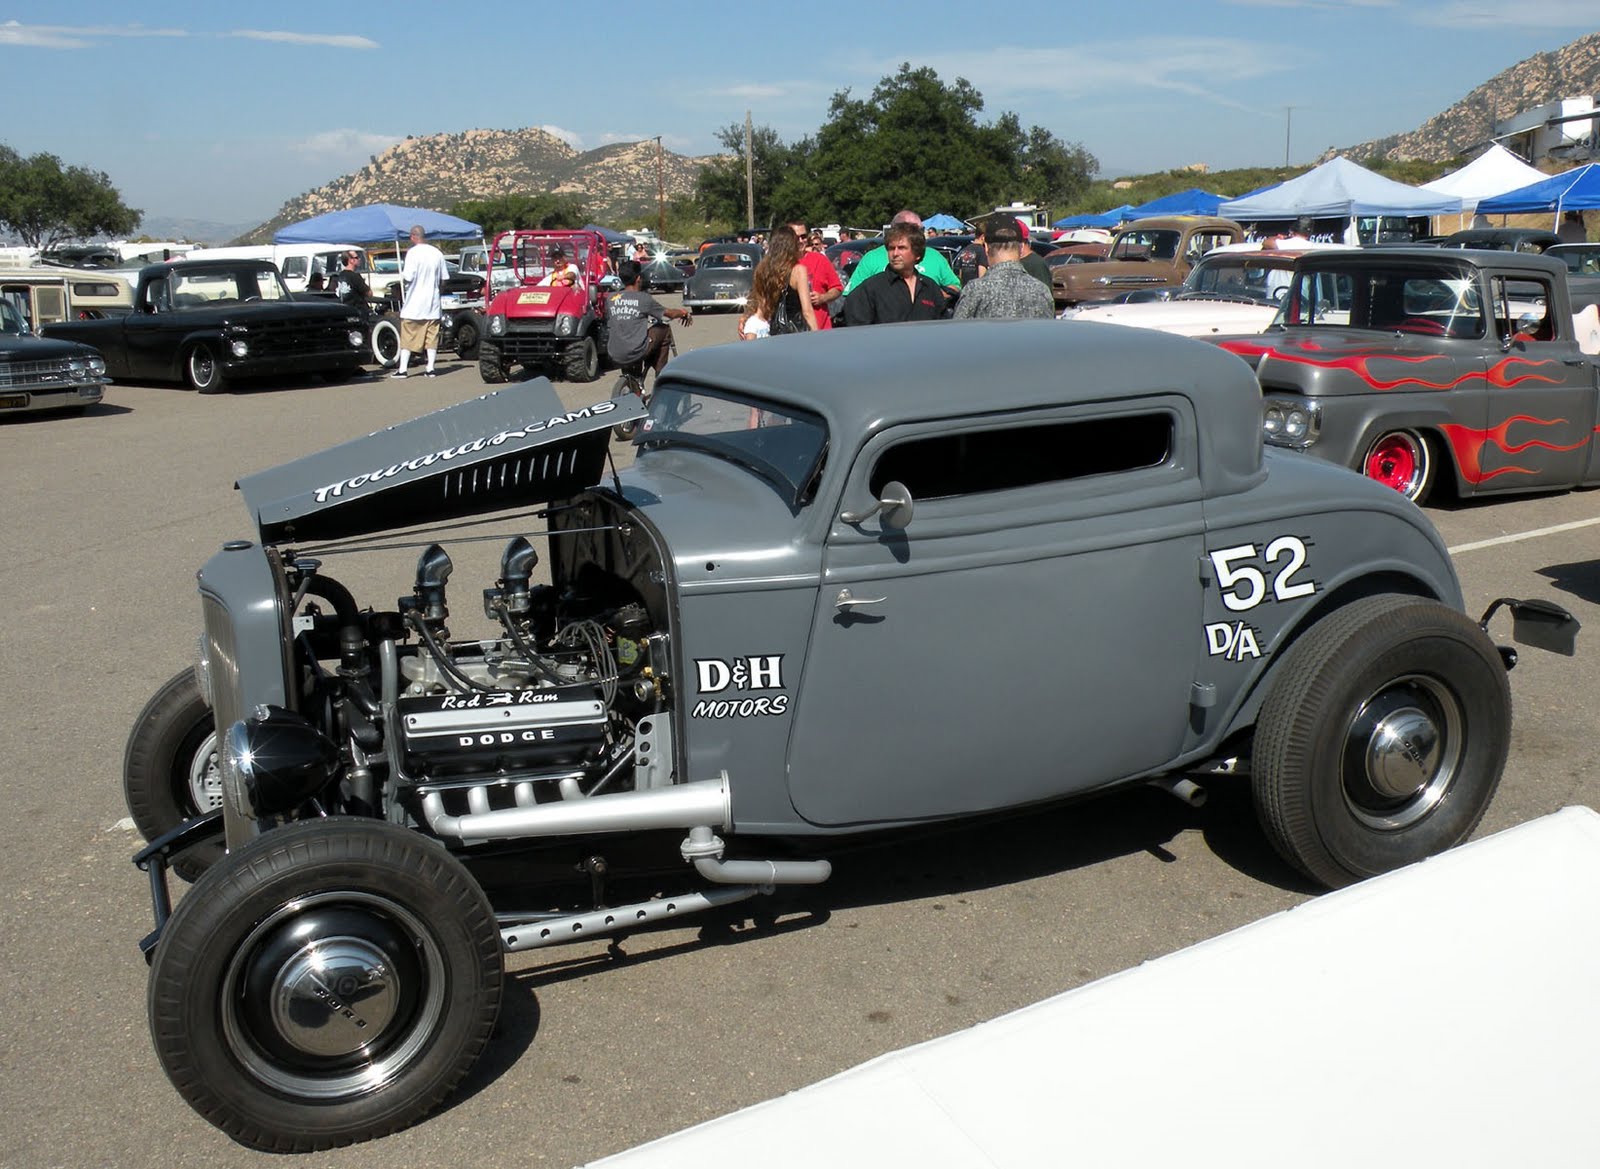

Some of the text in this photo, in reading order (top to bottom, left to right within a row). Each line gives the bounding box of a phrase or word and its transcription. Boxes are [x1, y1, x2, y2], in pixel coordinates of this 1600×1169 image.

[610, 305, 640, 317] Rockers
[523, 401, 617, 433] CAMS
[1208, 534, 1317, 611] 52
[1204, 620, 1263, 662] D/A
[693, 654, 786, 694] D&H
[441, 690, 558, 709] Red Ram
[692, 694, 789, 719] MOTORS
[459, 729, 555, 747] DODGE
